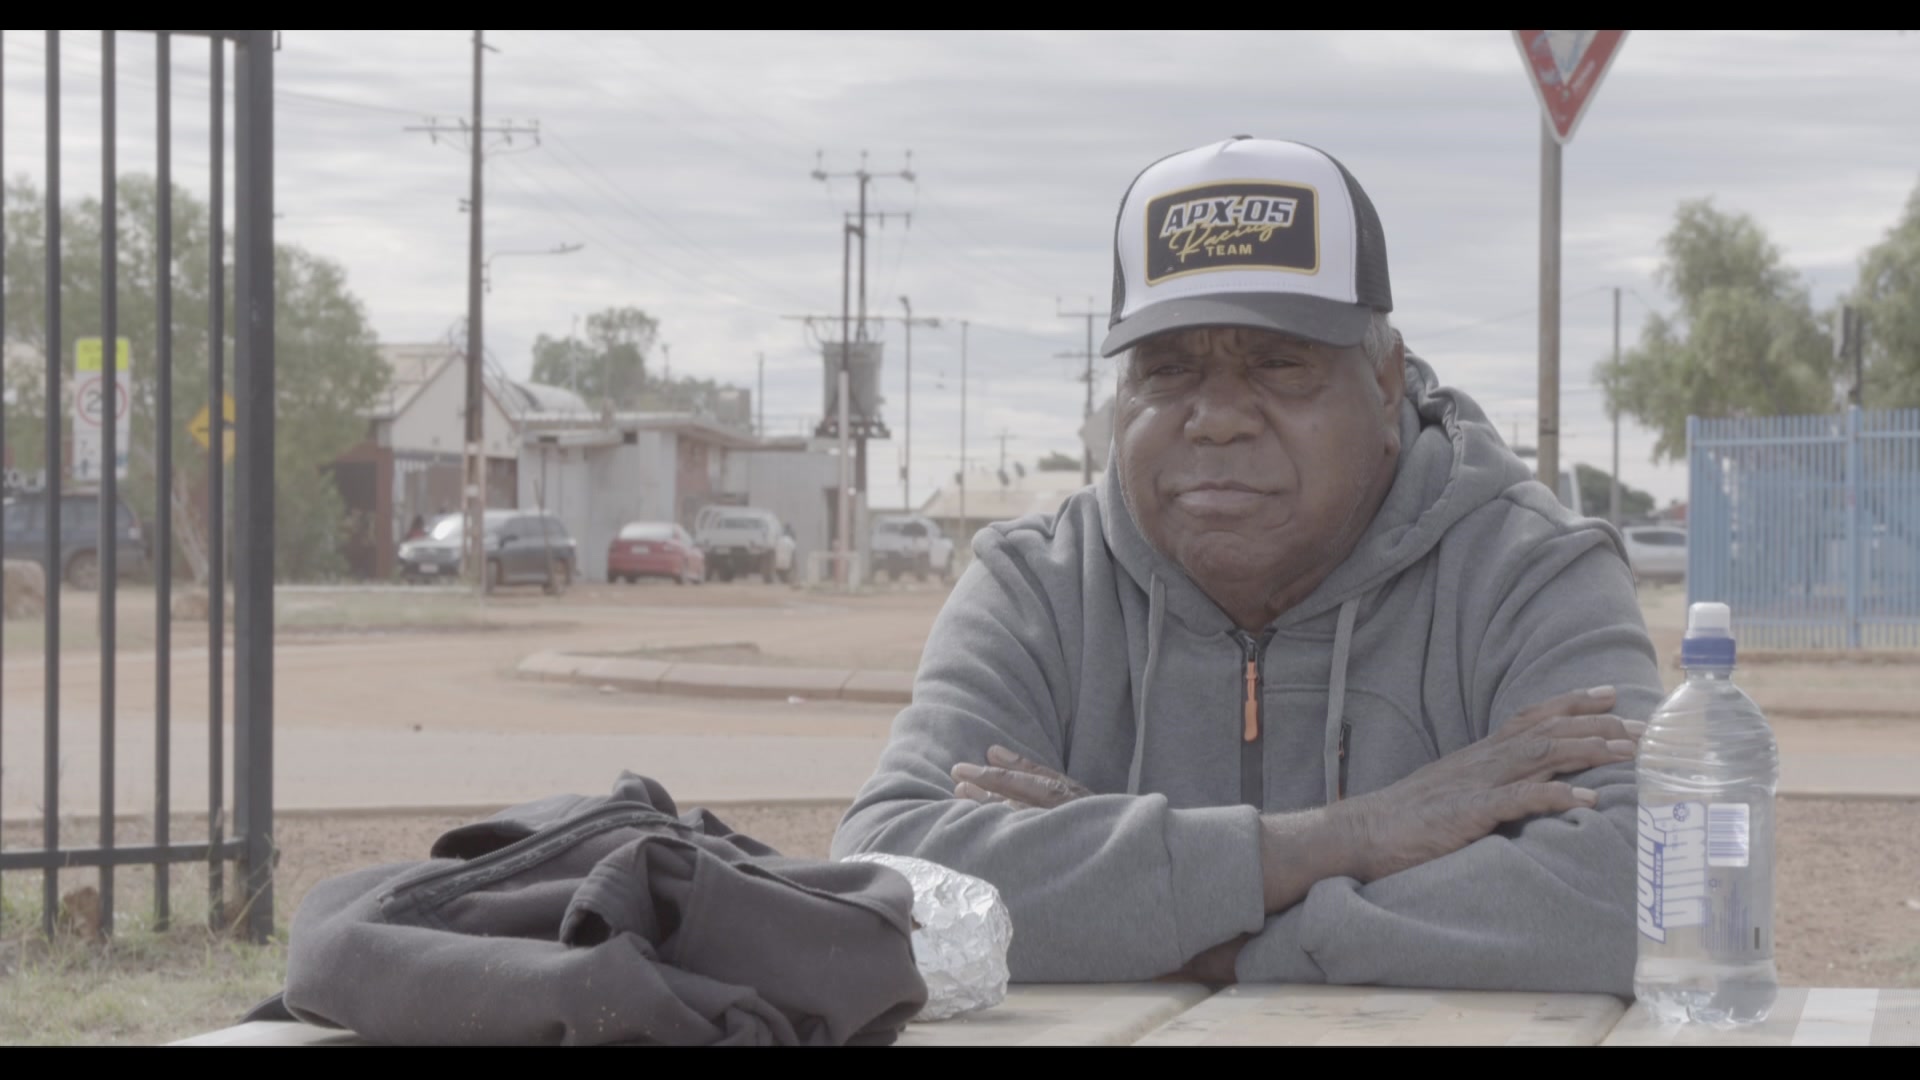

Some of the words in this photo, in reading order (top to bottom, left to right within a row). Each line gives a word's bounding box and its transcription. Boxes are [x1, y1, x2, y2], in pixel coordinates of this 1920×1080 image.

[1160, 196, 1297, 238] APX-05
[1168, 220, 1284, 263] Racing
[1206, 243, 1252, 257] TEAM
